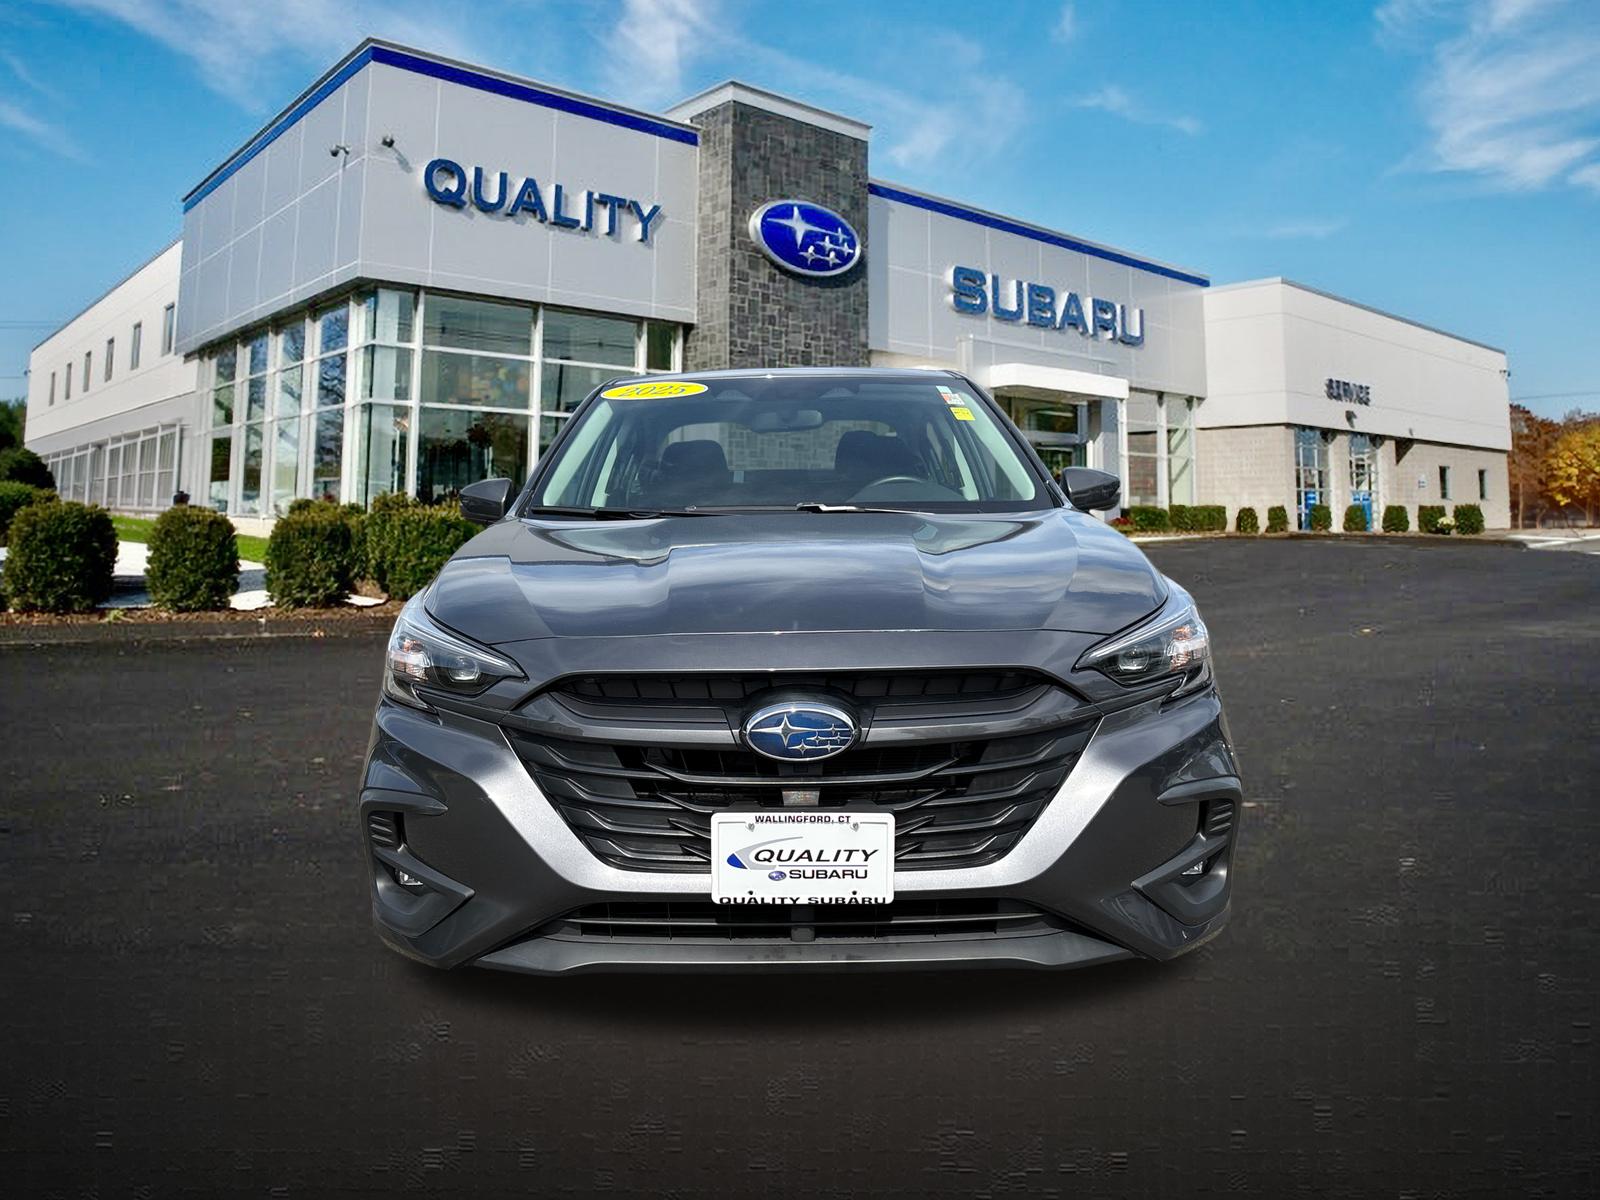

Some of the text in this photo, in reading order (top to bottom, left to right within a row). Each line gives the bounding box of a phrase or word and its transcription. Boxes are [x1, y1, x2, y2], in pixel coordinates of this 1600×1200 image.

[424, 158, 662, 242] QUALITY
[951, 265, 1145, 346] SUBARU
[755, 815, 851, 825] WALLINGFORD, CT
[754, 849, 879, 862] QUALITY
[789, 869, 868, 879] SUBARU
[719, 896, 886, 905] QUALITY SUBARU
